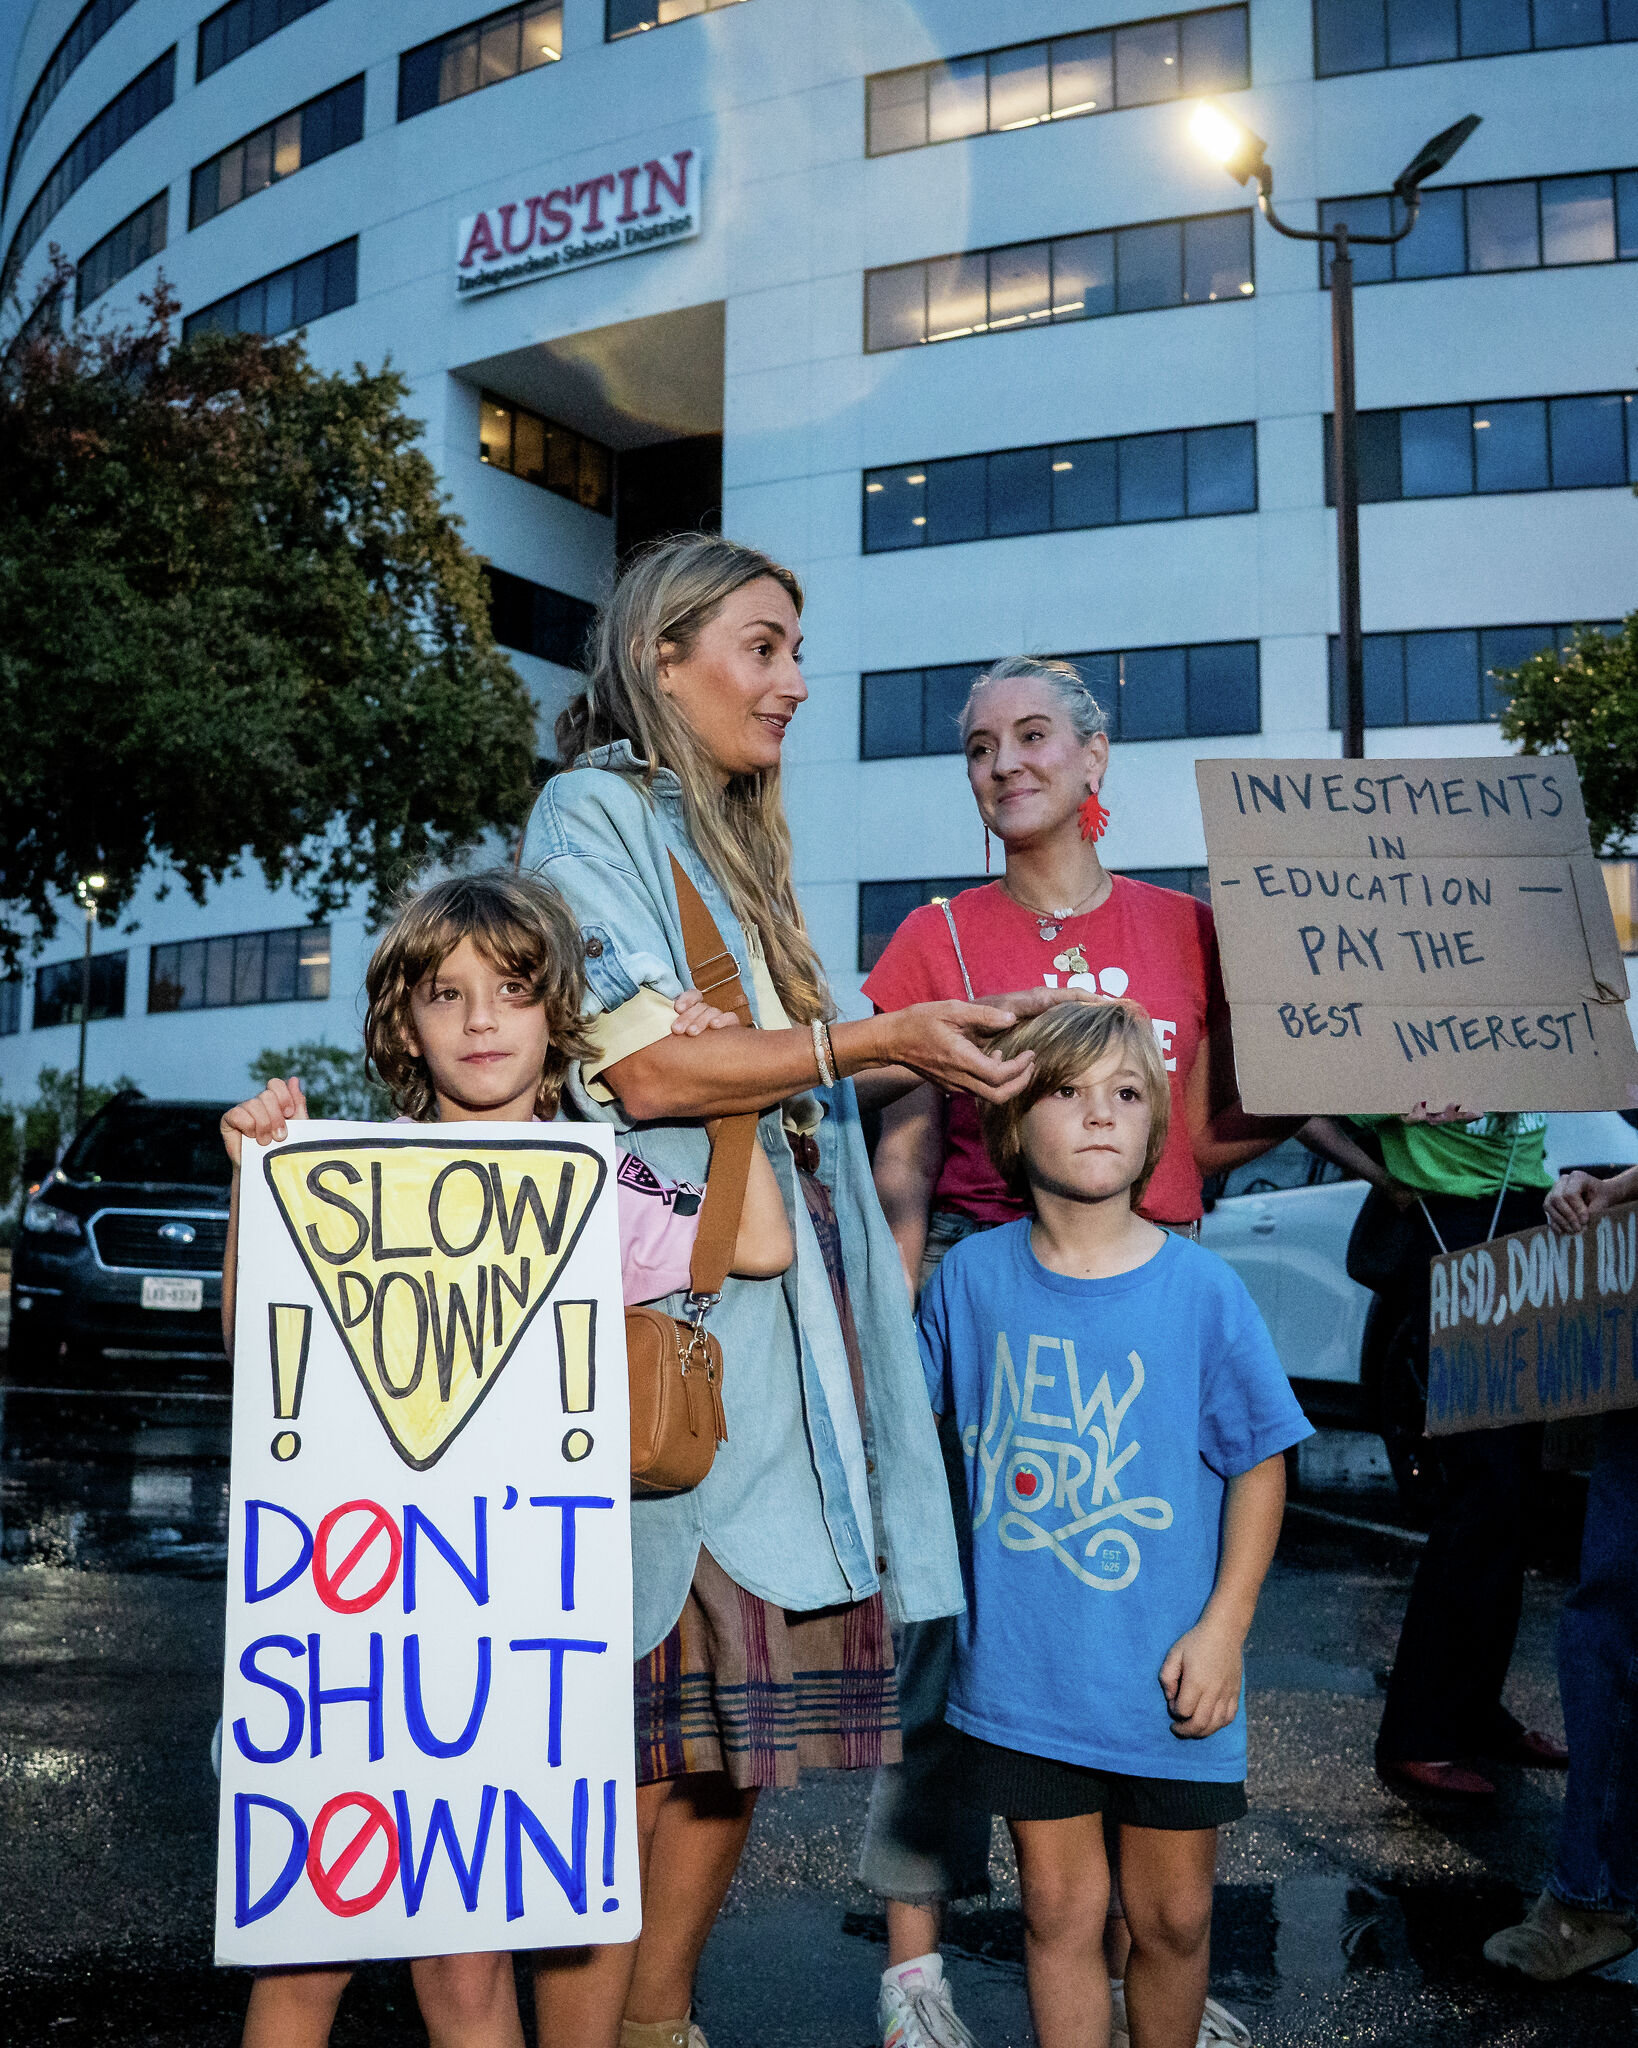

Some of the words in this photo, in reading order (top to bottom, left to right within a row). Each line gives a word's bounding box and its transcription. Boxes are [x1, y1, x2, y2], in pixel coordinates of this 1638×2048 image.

[457, 251, 560, 292] Independent
[563, 230, 620, 263] School
[624, 214, 693, 245] District
[458, 150, 693, 268] AUSTIN
[1231, 771, 1564, 820] INVESTMENTS
[1253, 863, 1492, 906] EDUCATION
[1368, 835, 1406, 860] IN
[1298, 924, 1384, 976] PAY
[1397, 930, 1485, 973] THE
[1277, 1001, 1363, 1038] BEST
[1393, 1001, 1599, 1062] INTEREST!
[305, 1160, 576, 1265] SLOW
[623, 1159, 644, 1181] MLS
[338, 1256, 530, 1402] DOWN
[1484, 1326, 1528, 1417] WE
[982, 1331, 1145, 1456] NEW
[962, 1412, 1142, 1530] YORK
[244, 1485, 615, 1614] DON'T
[1101, 1561, 1120, 1573] 1625
[232, 1632, 608, 1767] SHUT
[234, 1778, 620, 1929] DOWN!
